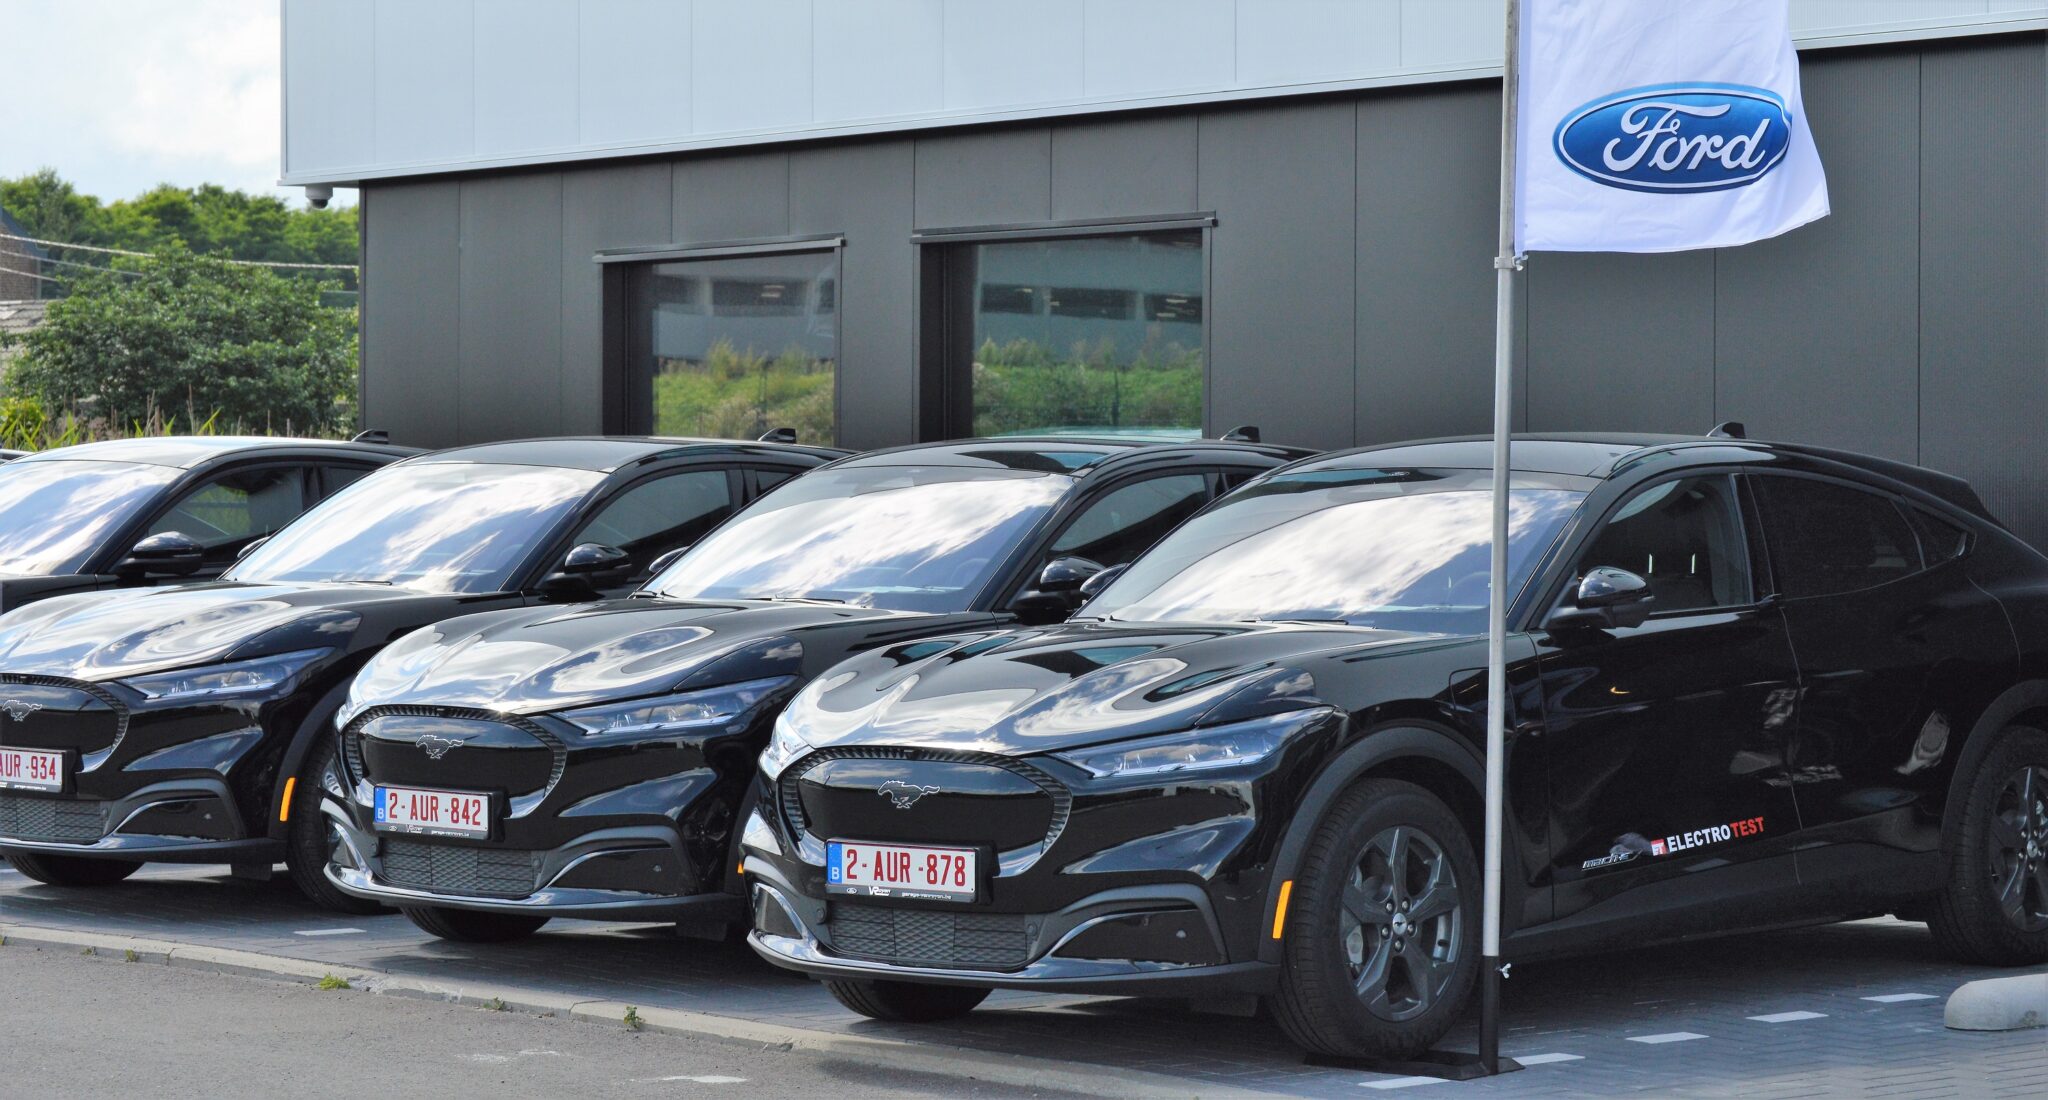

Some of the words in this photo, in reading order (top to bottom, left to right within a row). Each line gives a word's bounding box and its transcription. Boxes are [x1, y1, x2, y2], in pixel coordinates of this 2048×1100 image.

[1603, 102, 1771, 172] Ford
[377, 807, 385, 819] B
[831, 866, 840, 880] B
